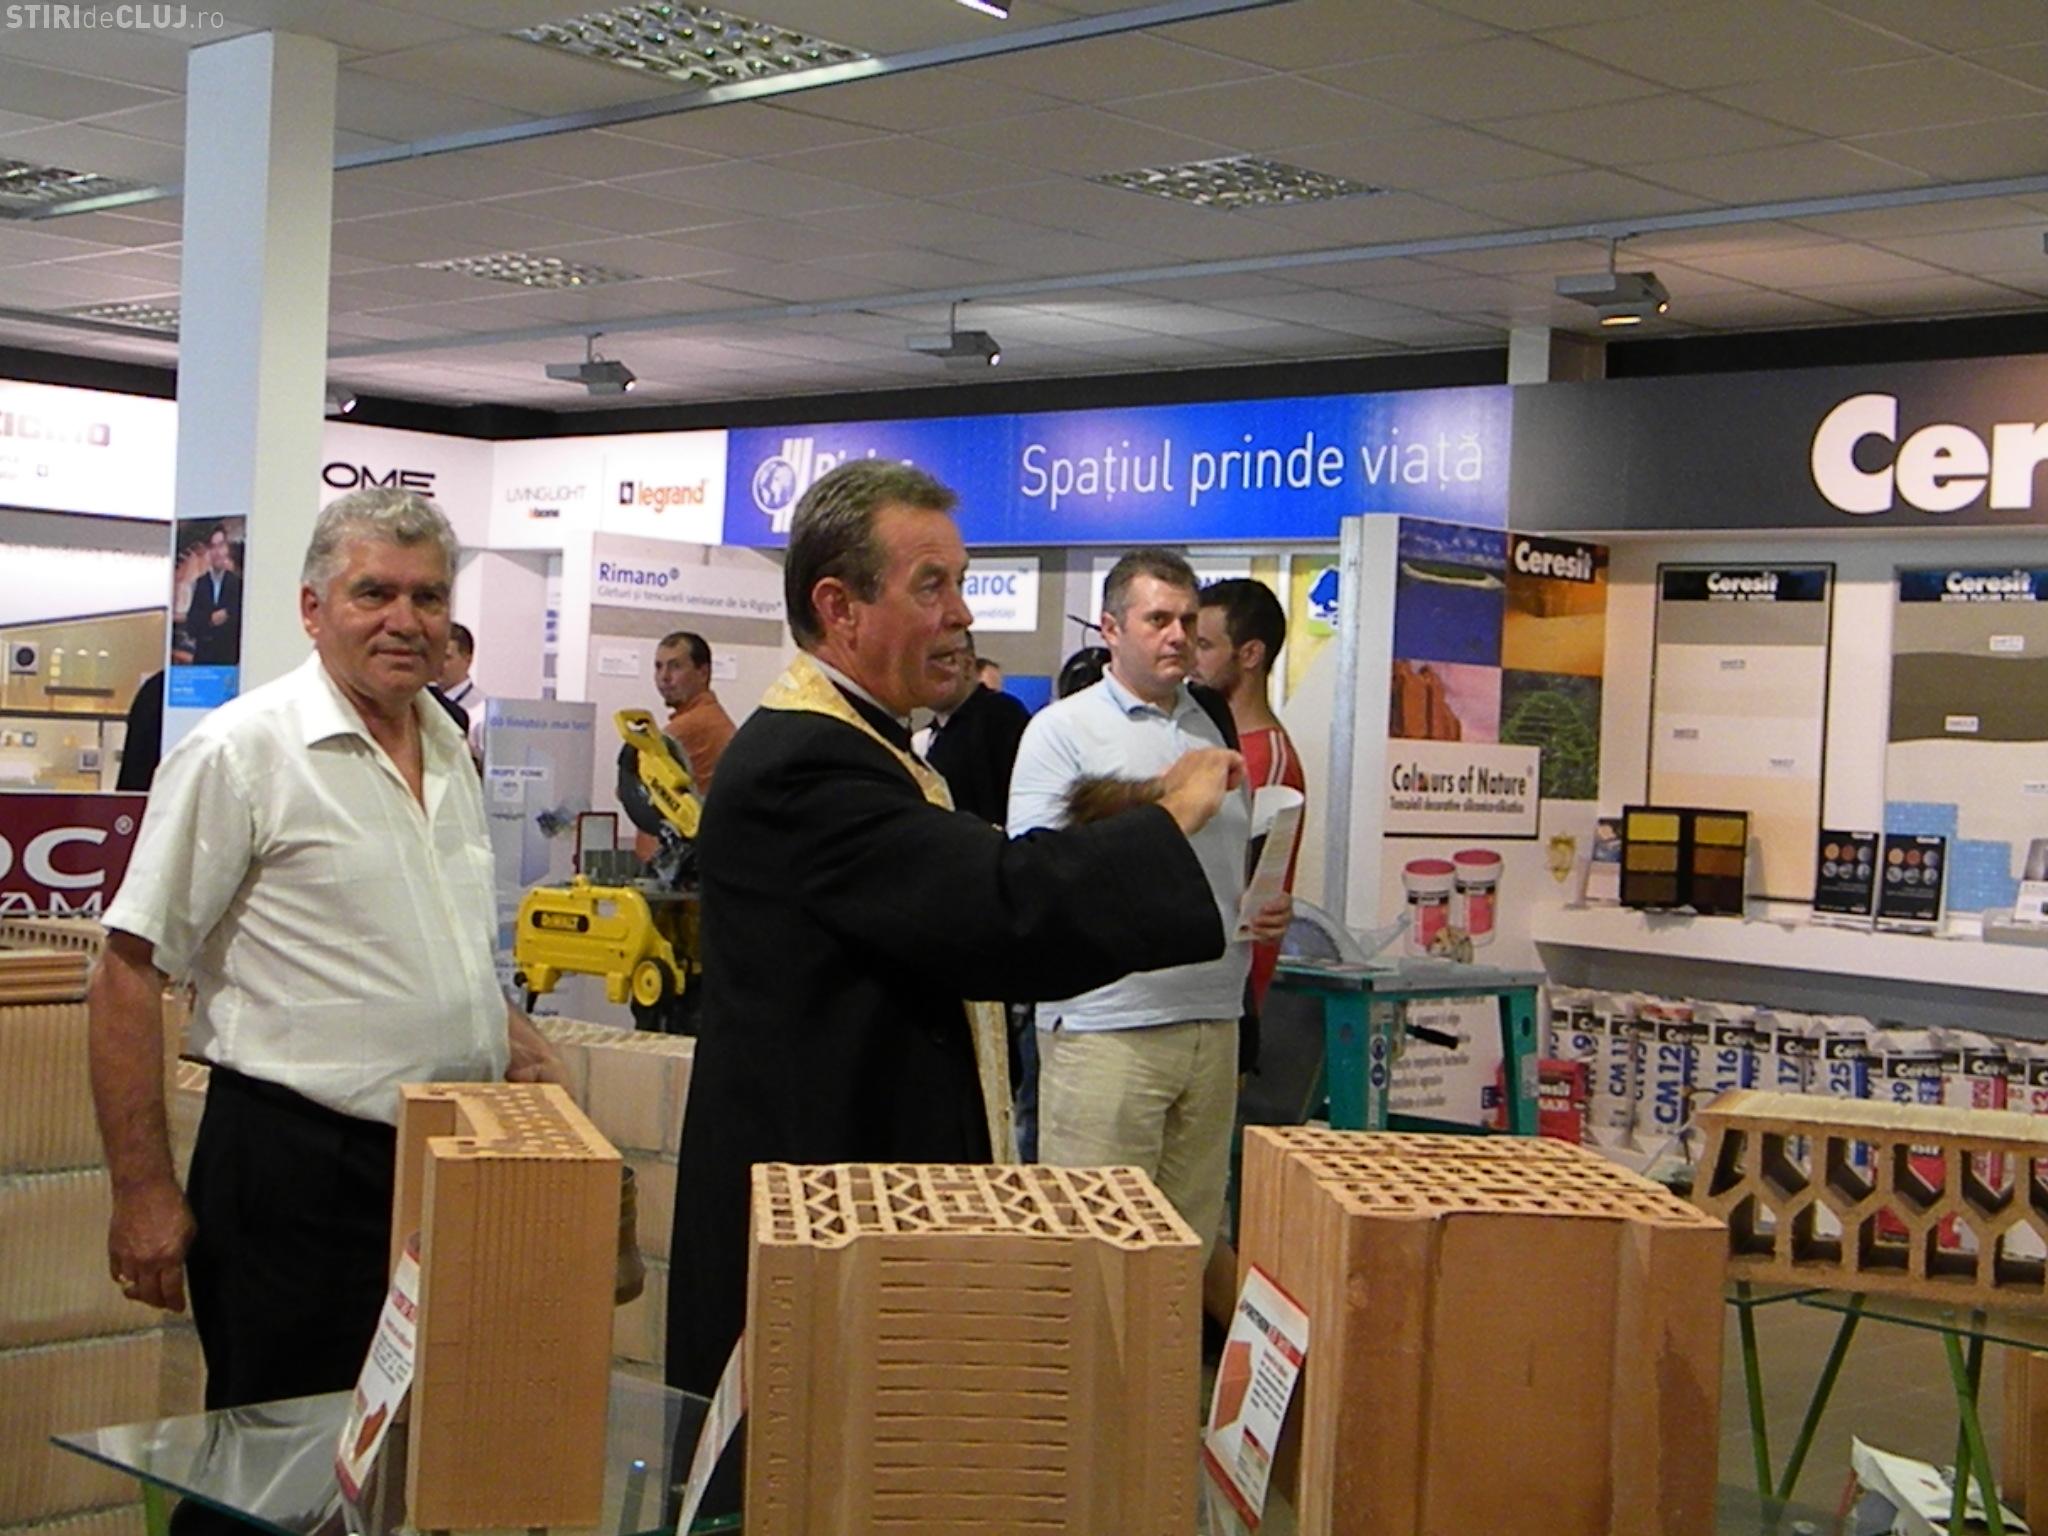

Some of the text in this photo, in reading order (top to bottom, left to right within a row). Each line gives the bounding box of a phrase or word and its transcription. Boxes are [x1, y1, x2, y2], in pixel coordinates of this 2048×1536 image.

[1190, 431, 1344, 507] prinde
[1811, 393, 2048, 514] Cer
[638, 479, 706, 513] legrand
[1514, 540, 1594, 580] Ceresit
[1707, 571, 1779, 593] Ceresit
[1945, 569, 2032, 594] Ceresit
[1458, 765, 1475, 794] of
[1476, 766, 1527, 796] Nature
[1654, 1044, 1682, 1125] CM 12
[1830, 1061, 1852, 1093] 25
